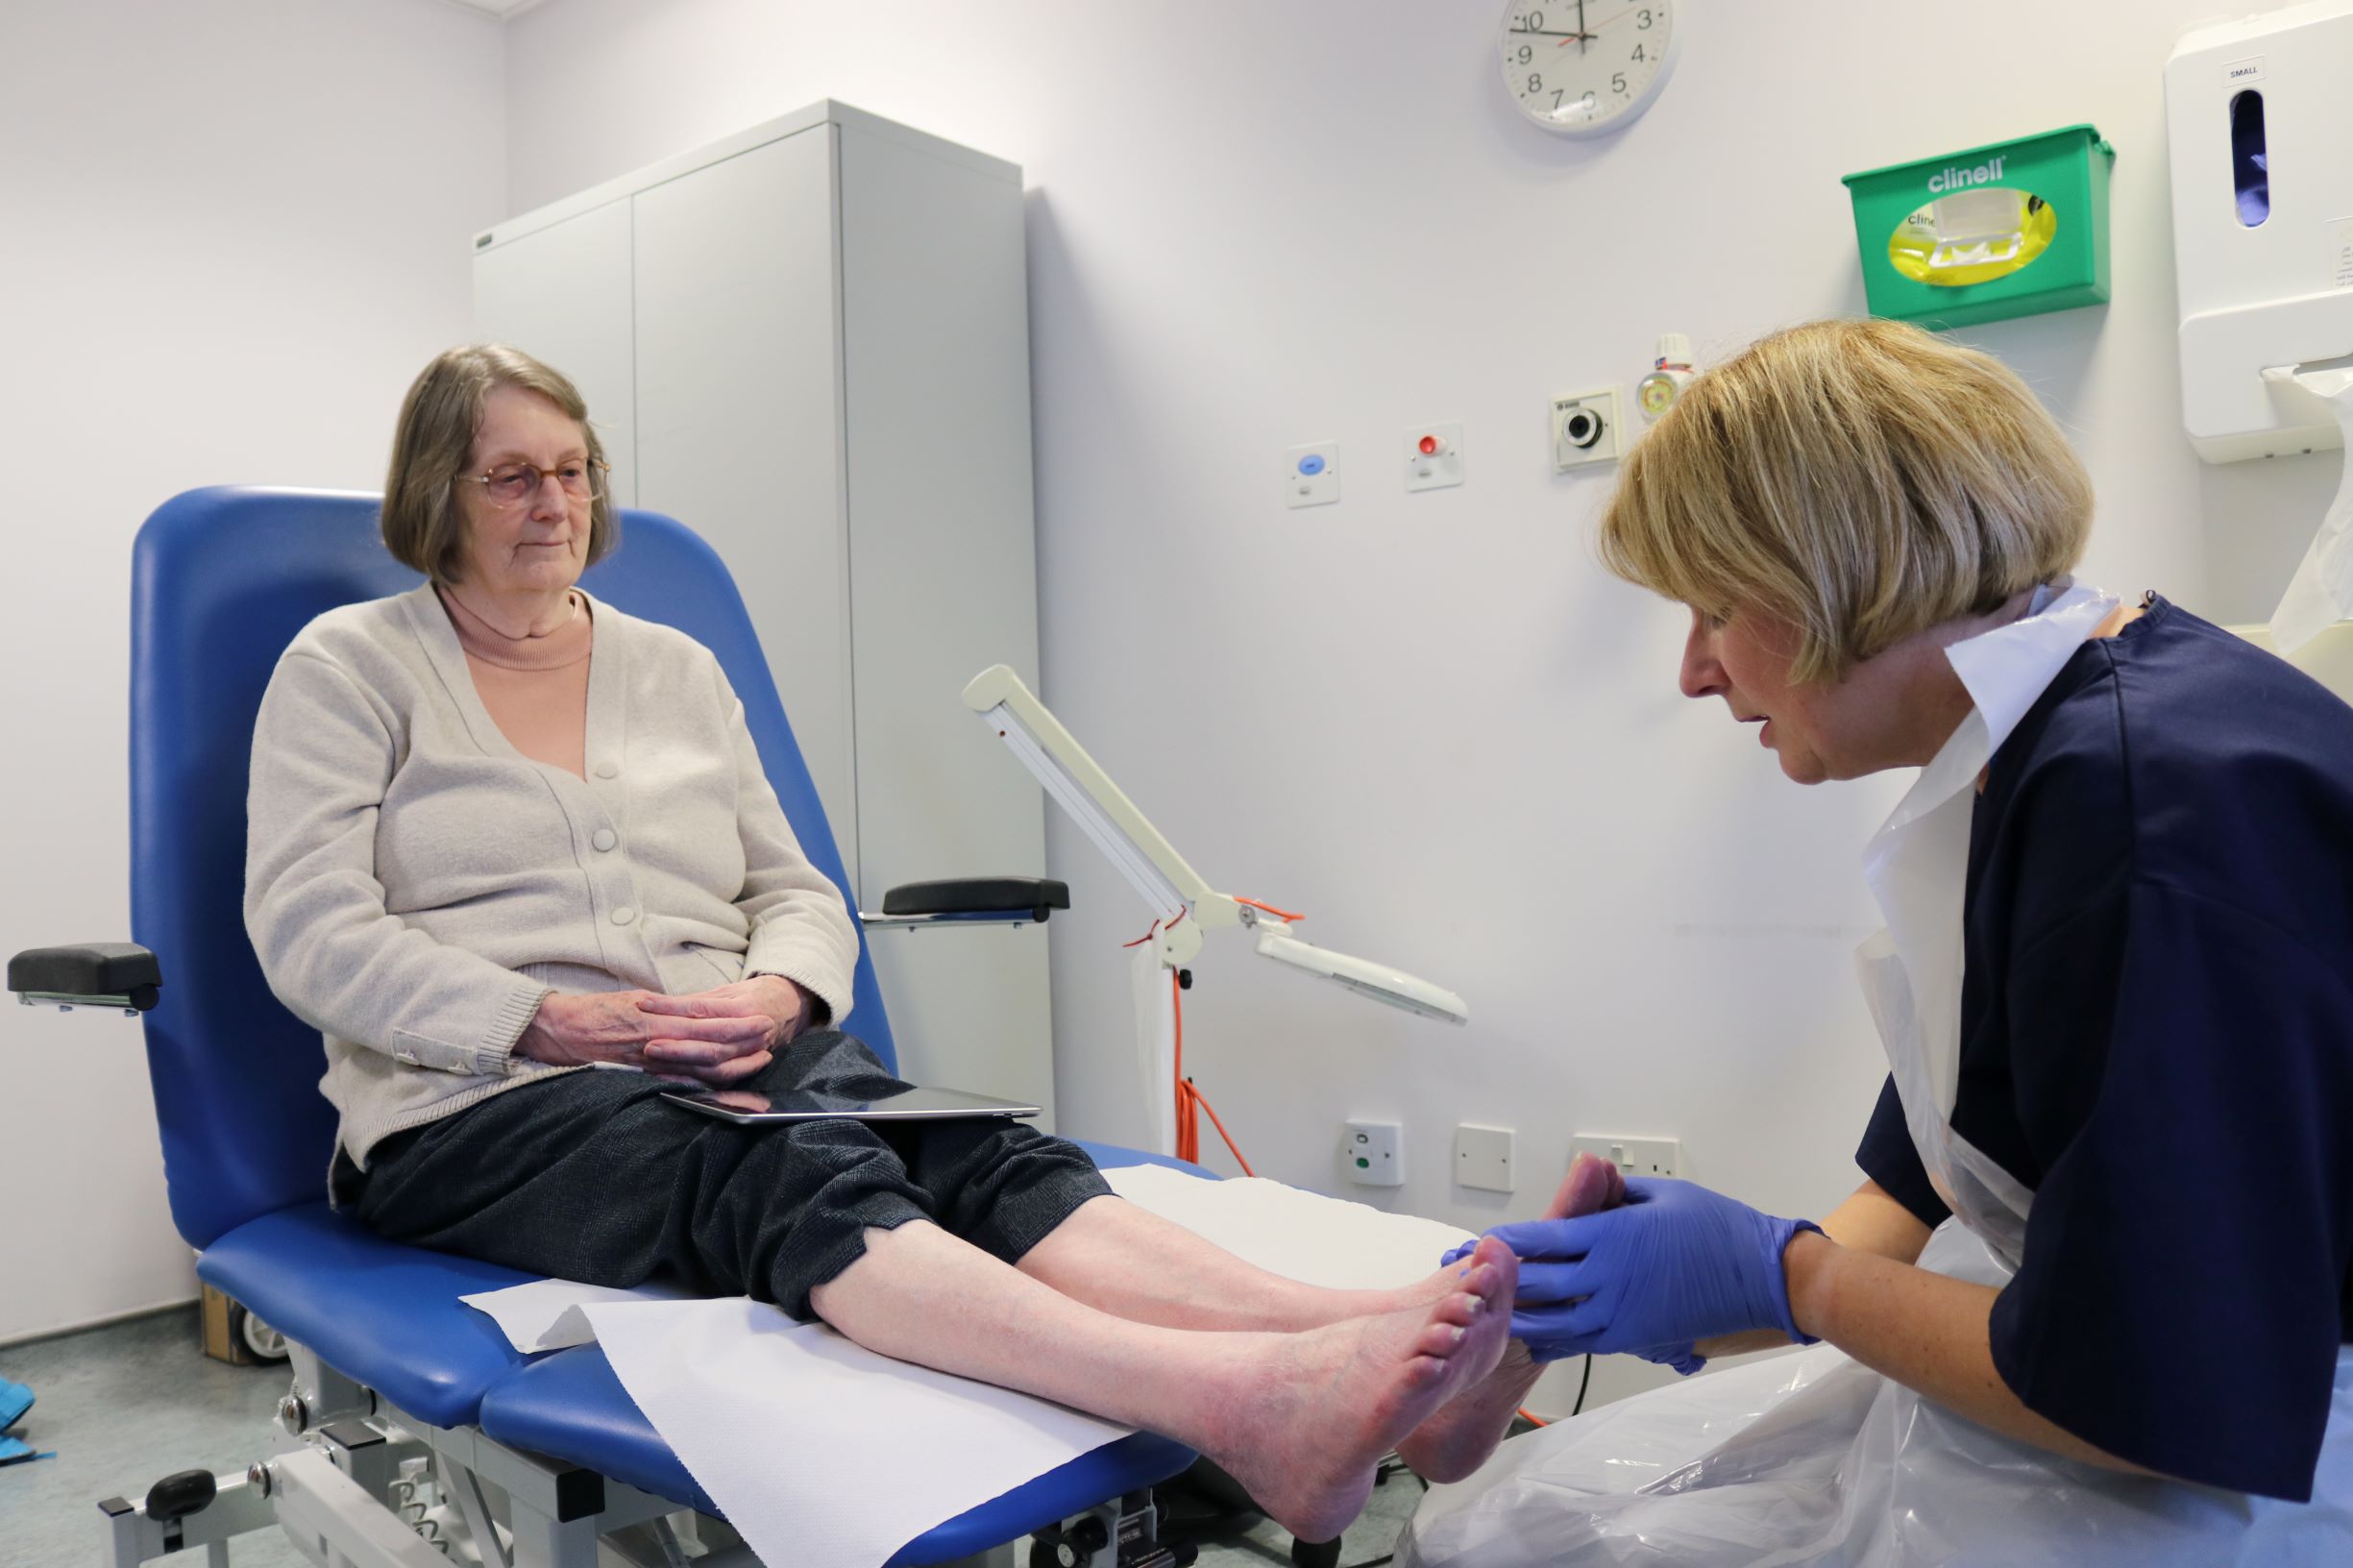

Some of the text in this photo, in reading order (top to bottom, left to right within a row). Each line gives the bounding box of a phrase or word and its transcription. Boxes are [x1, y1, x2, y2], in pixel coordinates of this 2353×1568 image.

[1521, 11, 1543, 32] 10
[1637, 10, 1652, 30] 3
[1518, 45, 1532, 65] 9
[1630, 43, 1647, 62] 4
[1612, 71, 1627, 93] 5
[2230, 66, 2259, 79] SMALL
[1528, 73, 1542, 93] 8
[1551, 89, 1564, 110] 7
[1581, 90, 1597, 110] 6
[1927, 158, 2003, 193] clinell
